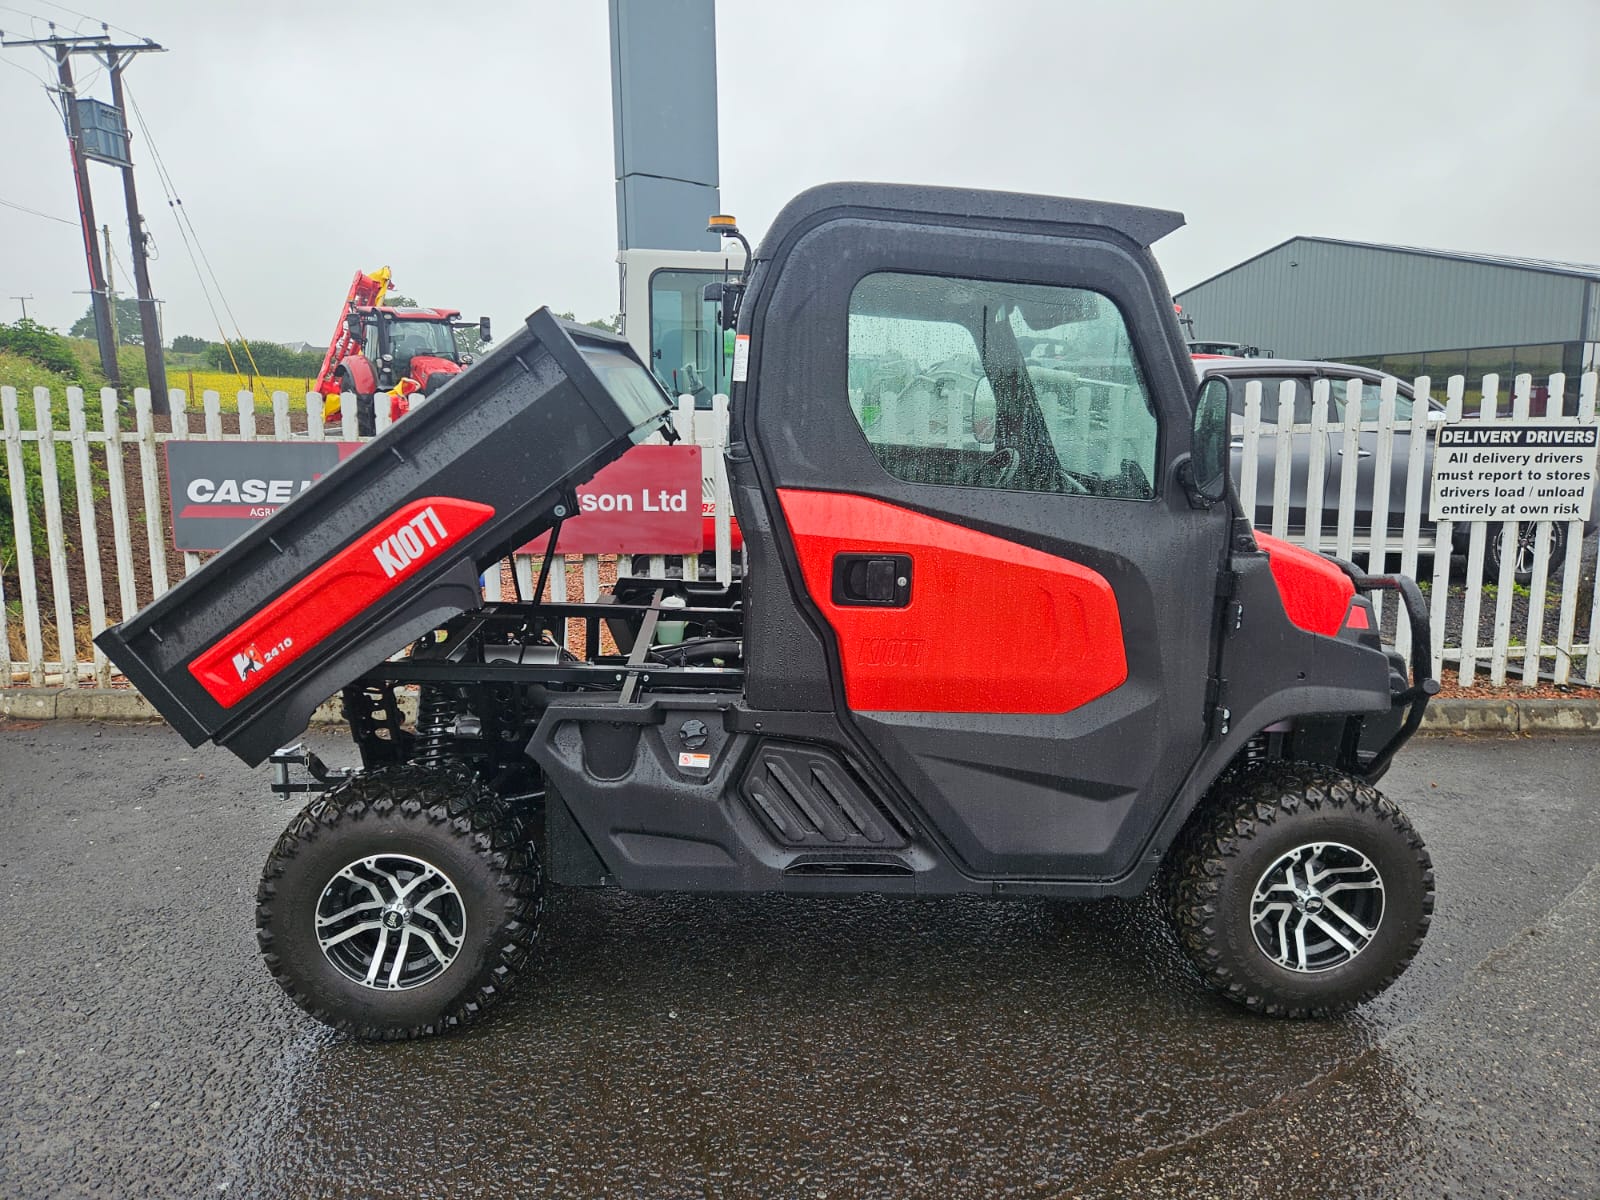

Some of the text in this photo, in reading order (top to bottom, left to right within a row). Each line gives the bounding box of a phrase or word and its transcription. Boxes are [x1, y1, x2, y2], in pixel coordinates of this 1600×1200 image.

[1441, 430, 1595, 443] DELIVERY DRIVERS
[1448, 452, 1583, 466] All delivery drivers
[1437, 470, 1591, 483] must report to stores
[187, 479, 293, 504] CASE
[1440, 486, 1490, 498] drivers
[1494, 486, 1525, 498] load
[1537, 486, 1585, 498] unload
[577, 488, 687, 512] son Ltd
[1441, 503, 1580, 517] entirely at own risk
[372, 506, 449, 579] KIOTI
[264, 637, 293, 663] 2410
